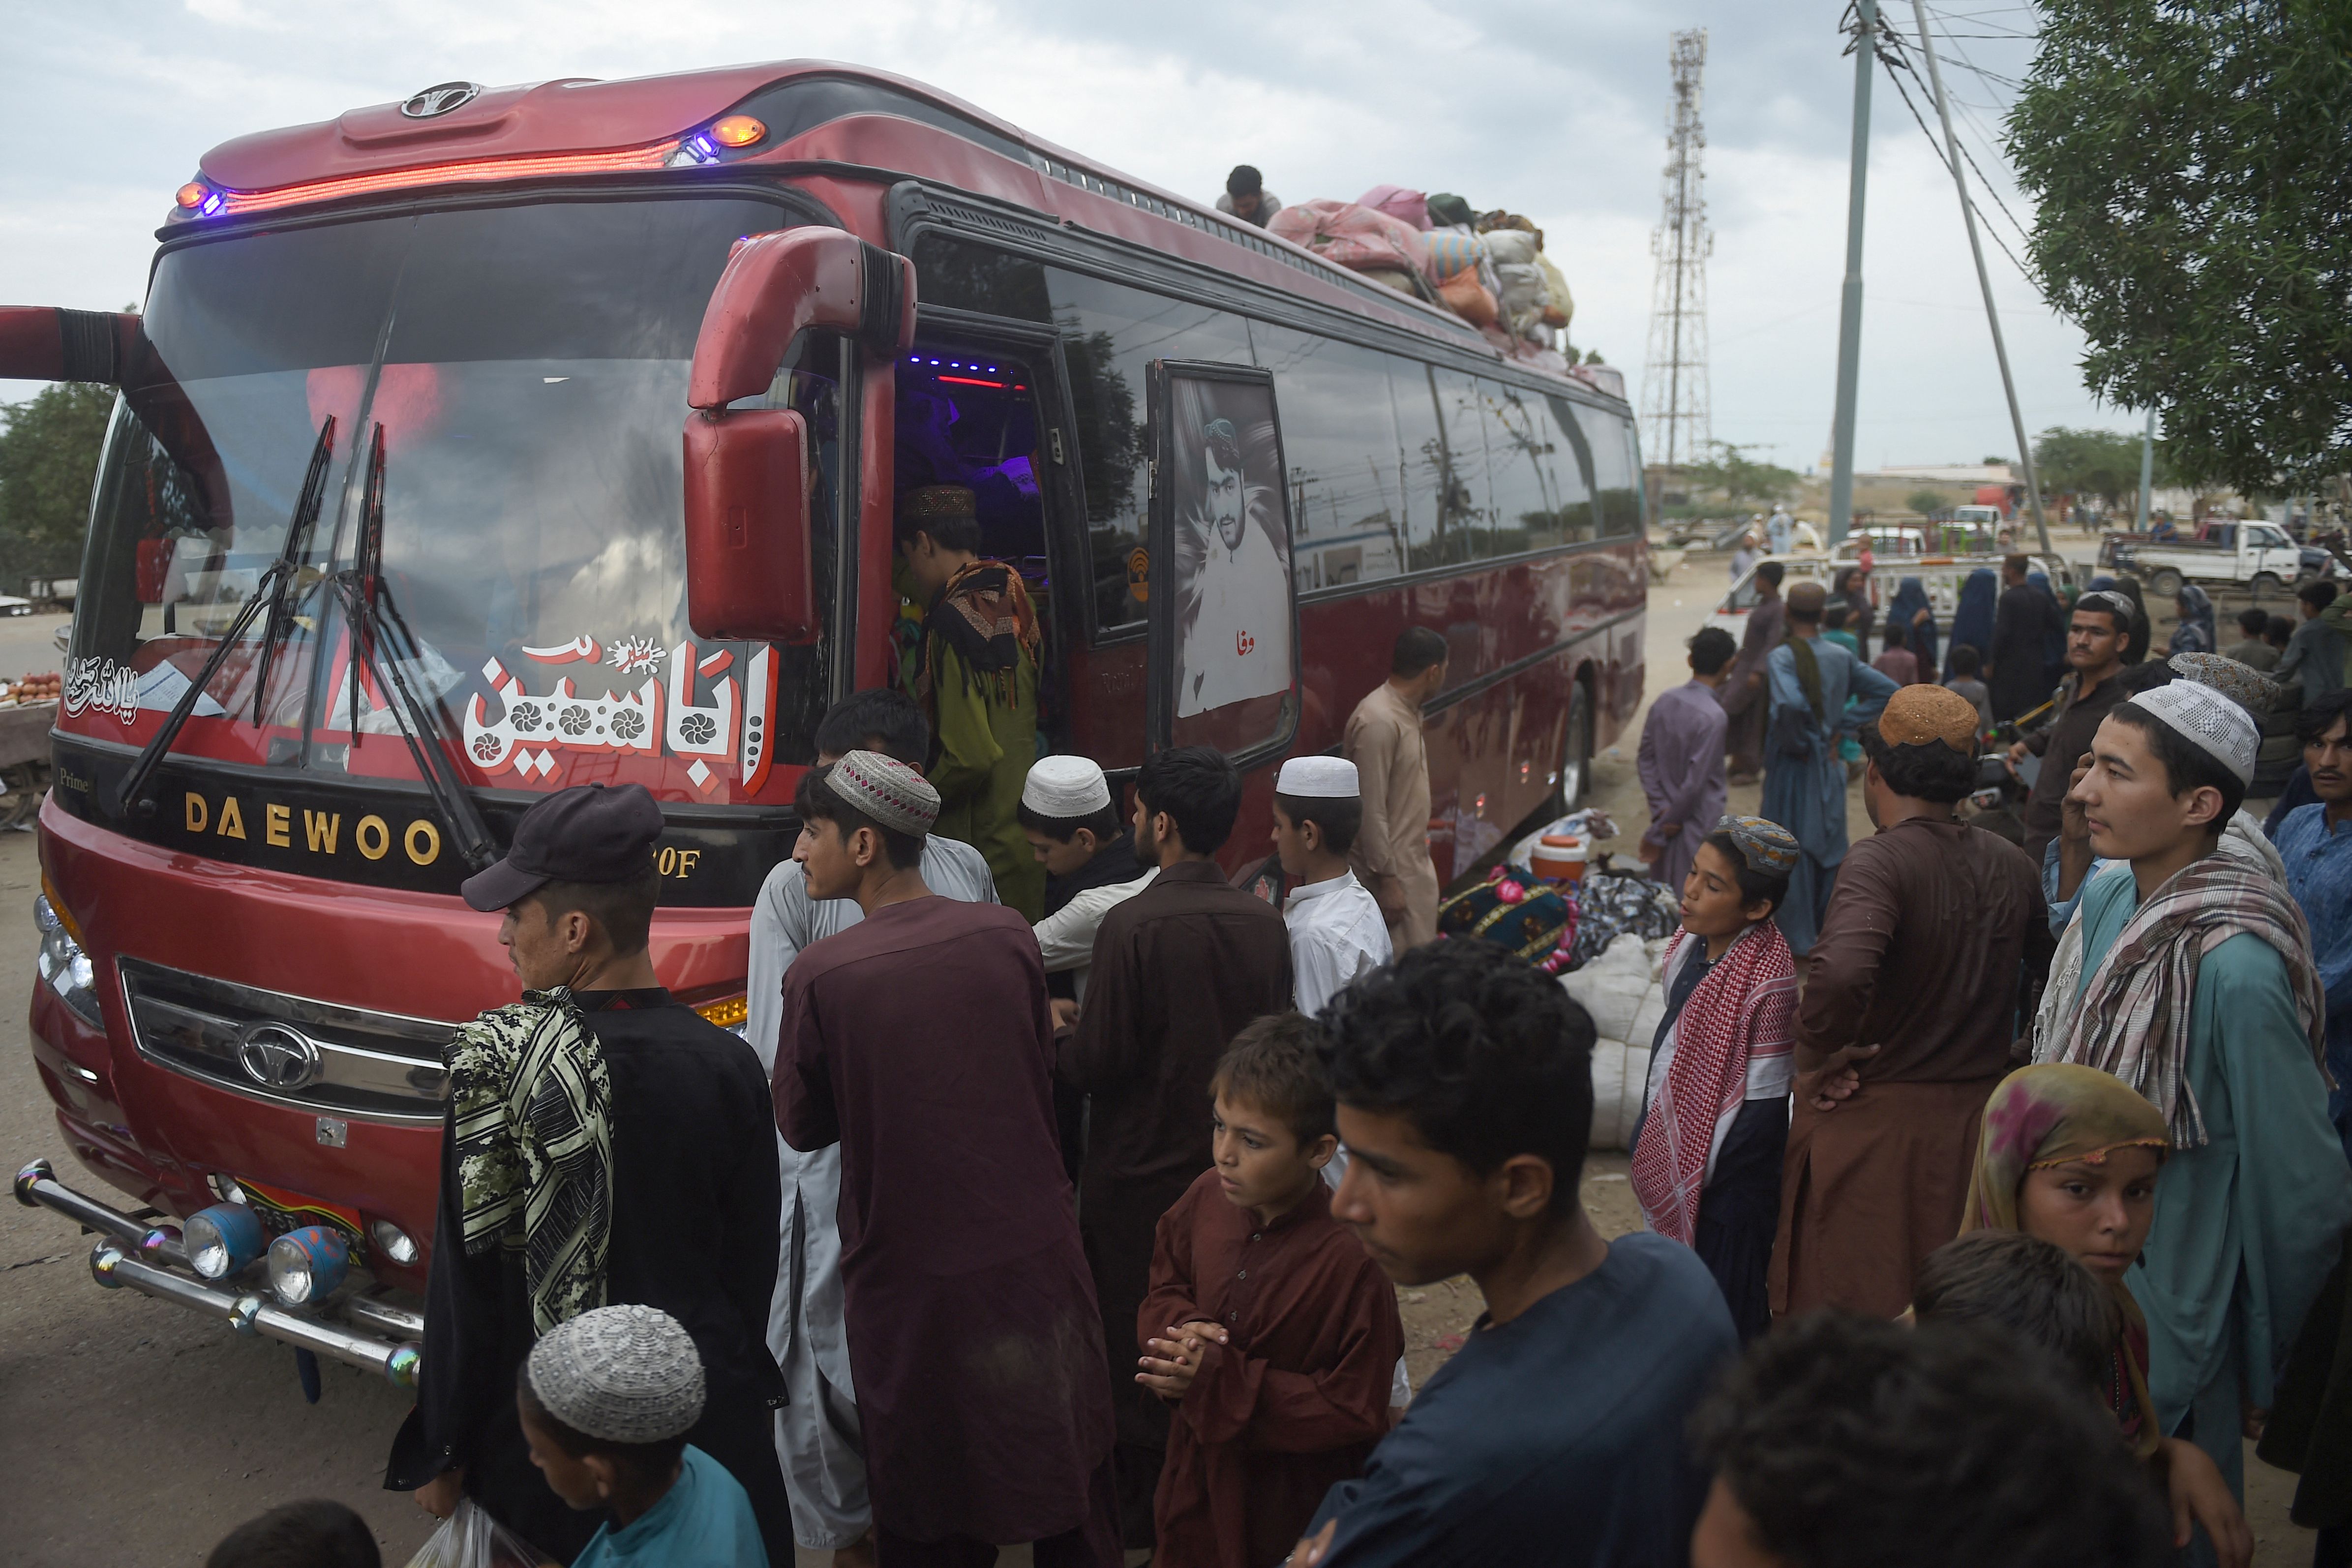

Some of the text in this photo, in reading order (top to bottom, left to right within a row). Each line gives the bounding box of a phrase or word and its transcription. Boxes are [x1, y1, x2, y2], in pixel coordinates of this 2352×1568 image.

[1236, 630, 1254, 656] وفا
[60, 767, 89, 792] Prime
[185, 791, 441, 866] DAEWOO
